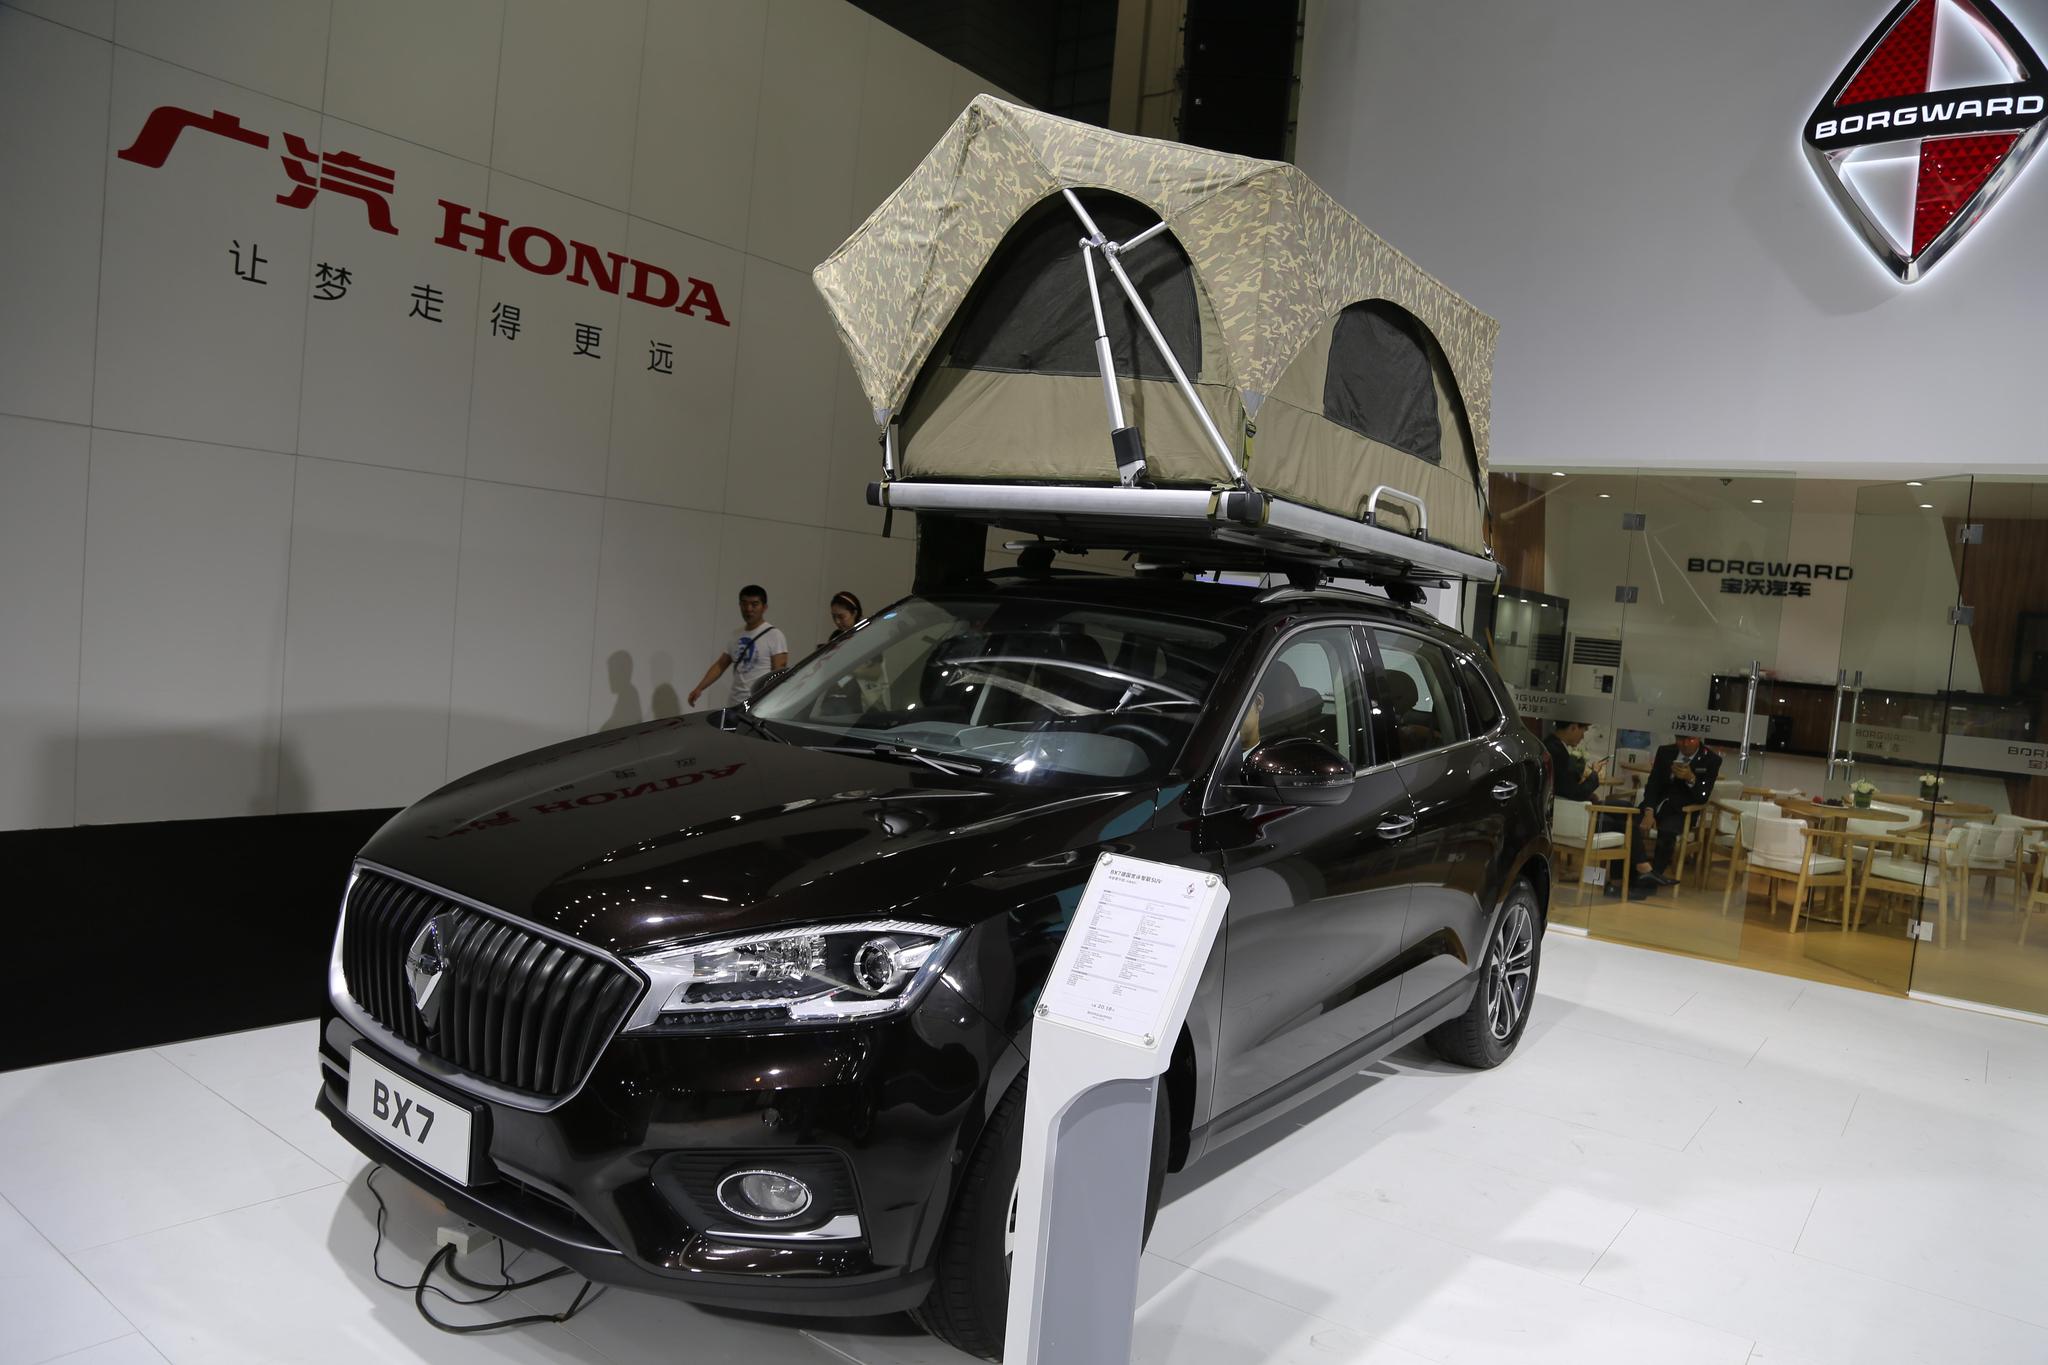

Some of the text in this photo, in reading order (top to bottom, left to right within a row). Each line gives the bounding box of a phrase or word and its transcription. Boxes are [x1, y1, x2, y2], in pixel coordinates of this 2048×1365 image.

[1814, 95, 2044, 140] BORGWARD
[117, 105, 731, 327] 广汽 HONDA
[227, 240, 675, 375] 让梦走得更远
[1687, 557, 1853, 581] BORGWARD
[1720, 578, 1812, 597] 宝沃汽车
[2007, 746, 2048, 758] BOR
[372, 1079, 435, 1145] BX7
